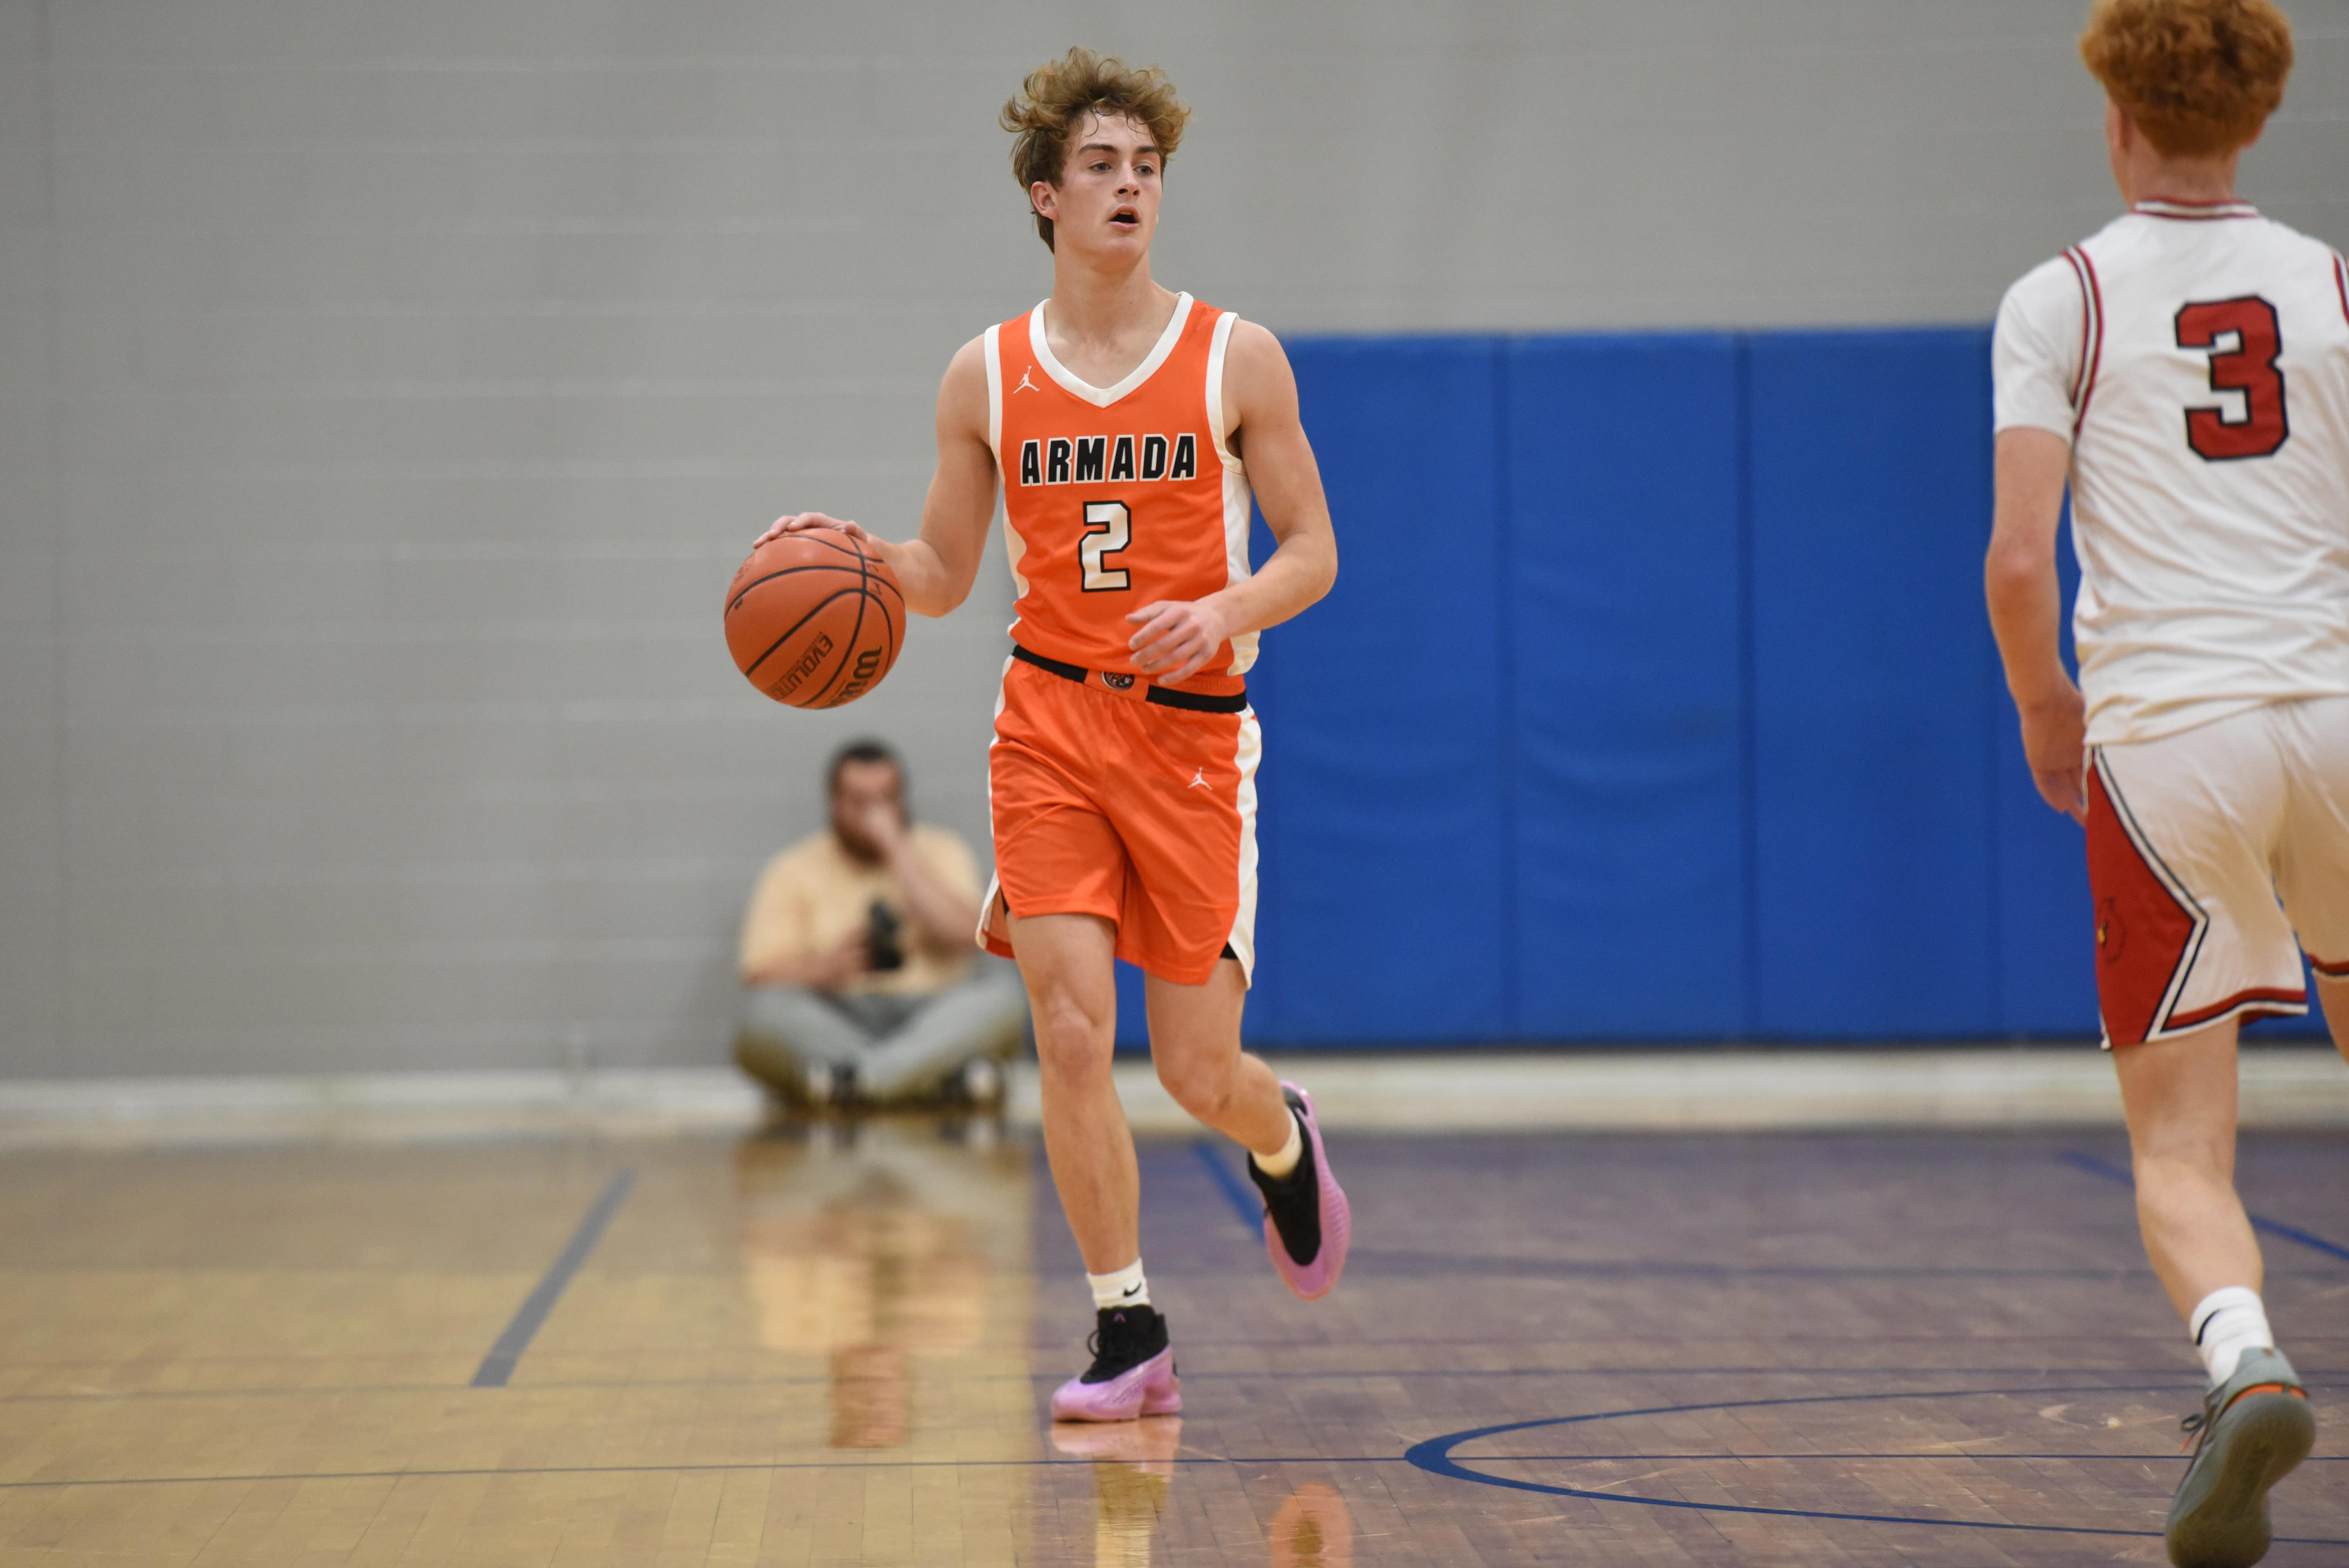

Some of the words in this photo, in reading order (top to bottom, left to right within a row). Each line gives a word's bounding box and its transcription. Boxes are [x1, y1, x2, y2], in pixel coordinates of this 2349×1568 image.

[2175, 294, 2289, 462] 3
[1020, 433, 1197, 487] ARMADA
[1078, 500, 1132, 592] 2
[769, 632, 833, 700] EVOLUTIO
